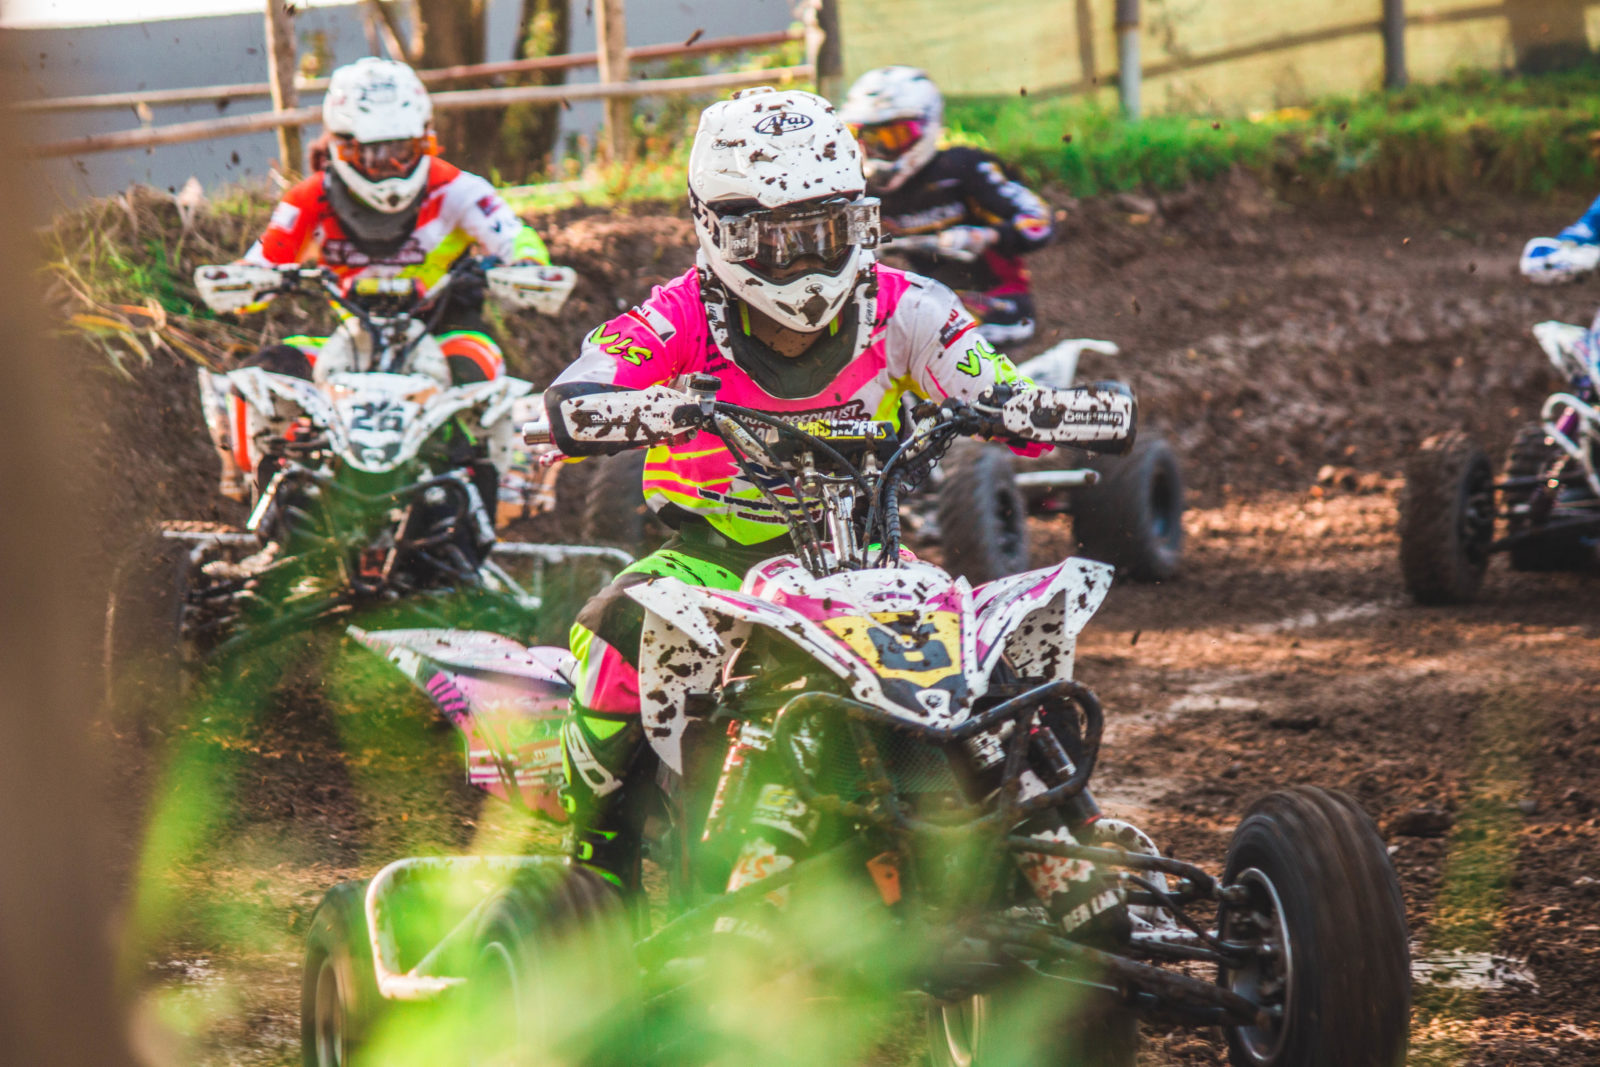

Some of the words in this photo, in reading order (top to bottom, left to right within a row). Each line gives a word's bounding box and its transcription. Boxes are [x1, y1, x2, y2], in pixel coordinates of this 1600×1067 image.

[761, 113, 808, 132] Arai
[589, 323, 653, 366] VLS
[956, 340, 998, 377] VL
[866, 618, 952, 672] 6
